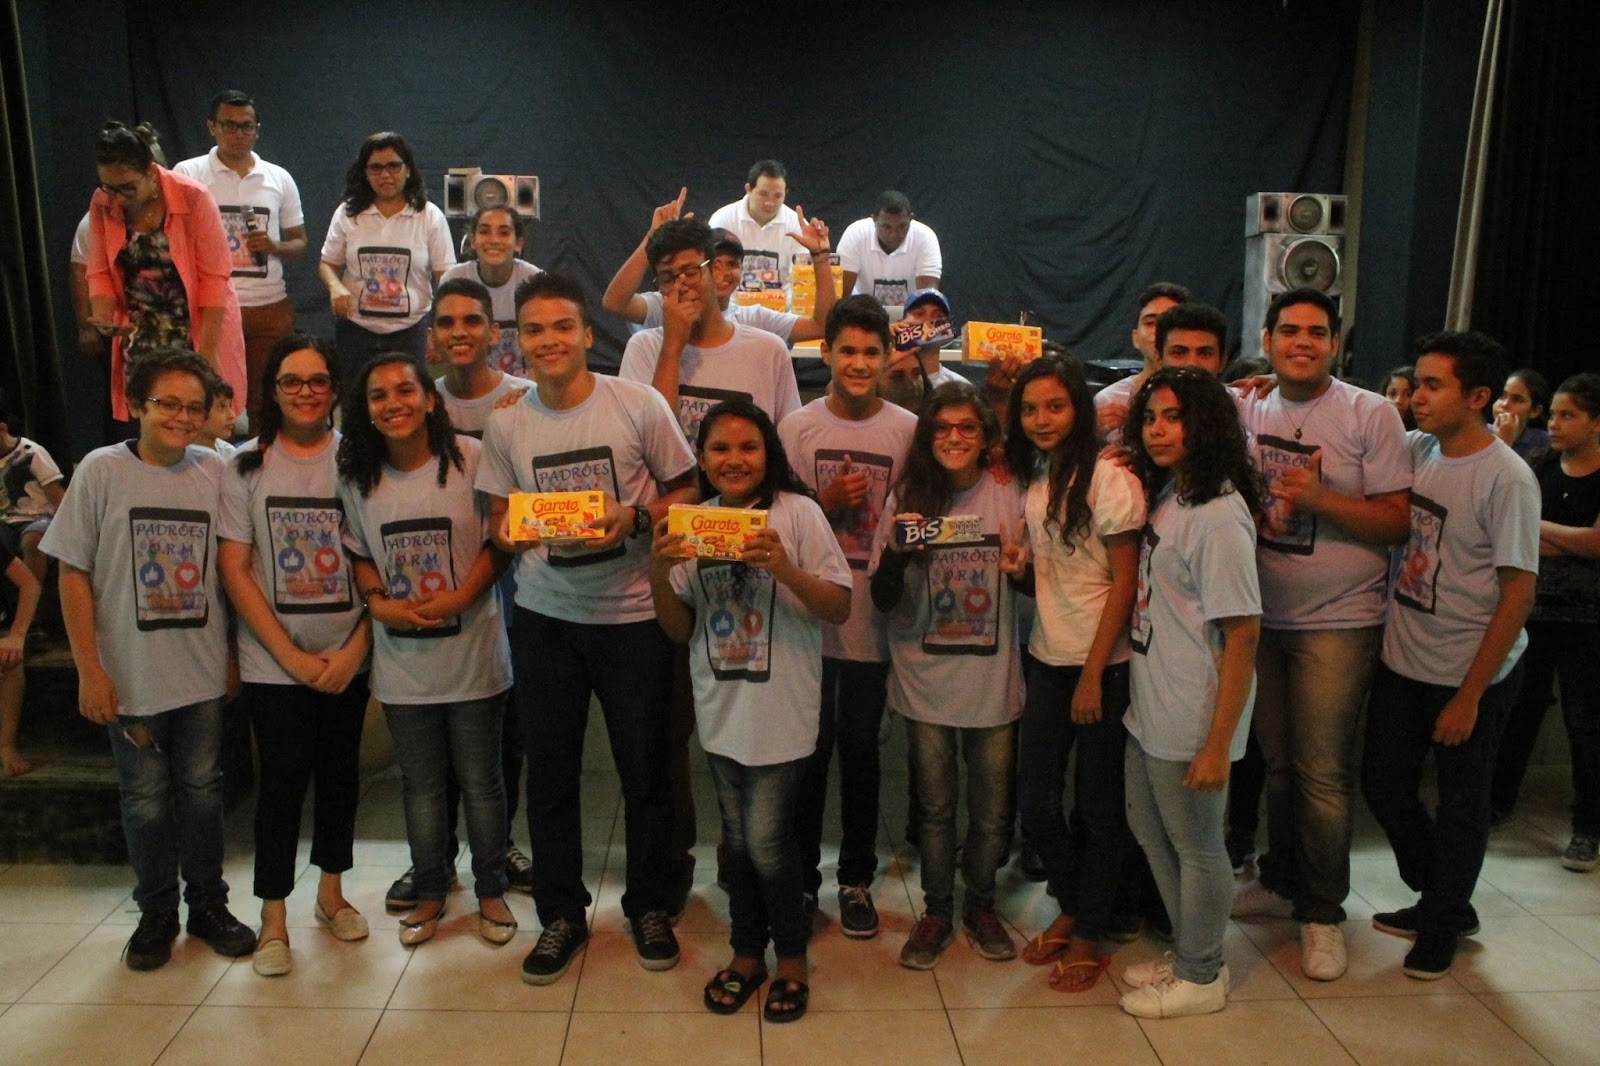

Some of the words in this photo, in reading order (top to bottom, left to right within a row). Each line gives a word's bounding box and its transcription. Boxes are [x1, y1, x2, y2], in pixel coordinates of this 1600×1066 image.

[986, 327, 1022, 343] Garoto
[539, 462, 610, 484] PADRÕES
[531, 498, 580, 517] Garoto
[135, 523, 205, 538] PADRÕES
[691, 514, 741, 533] Garoto
